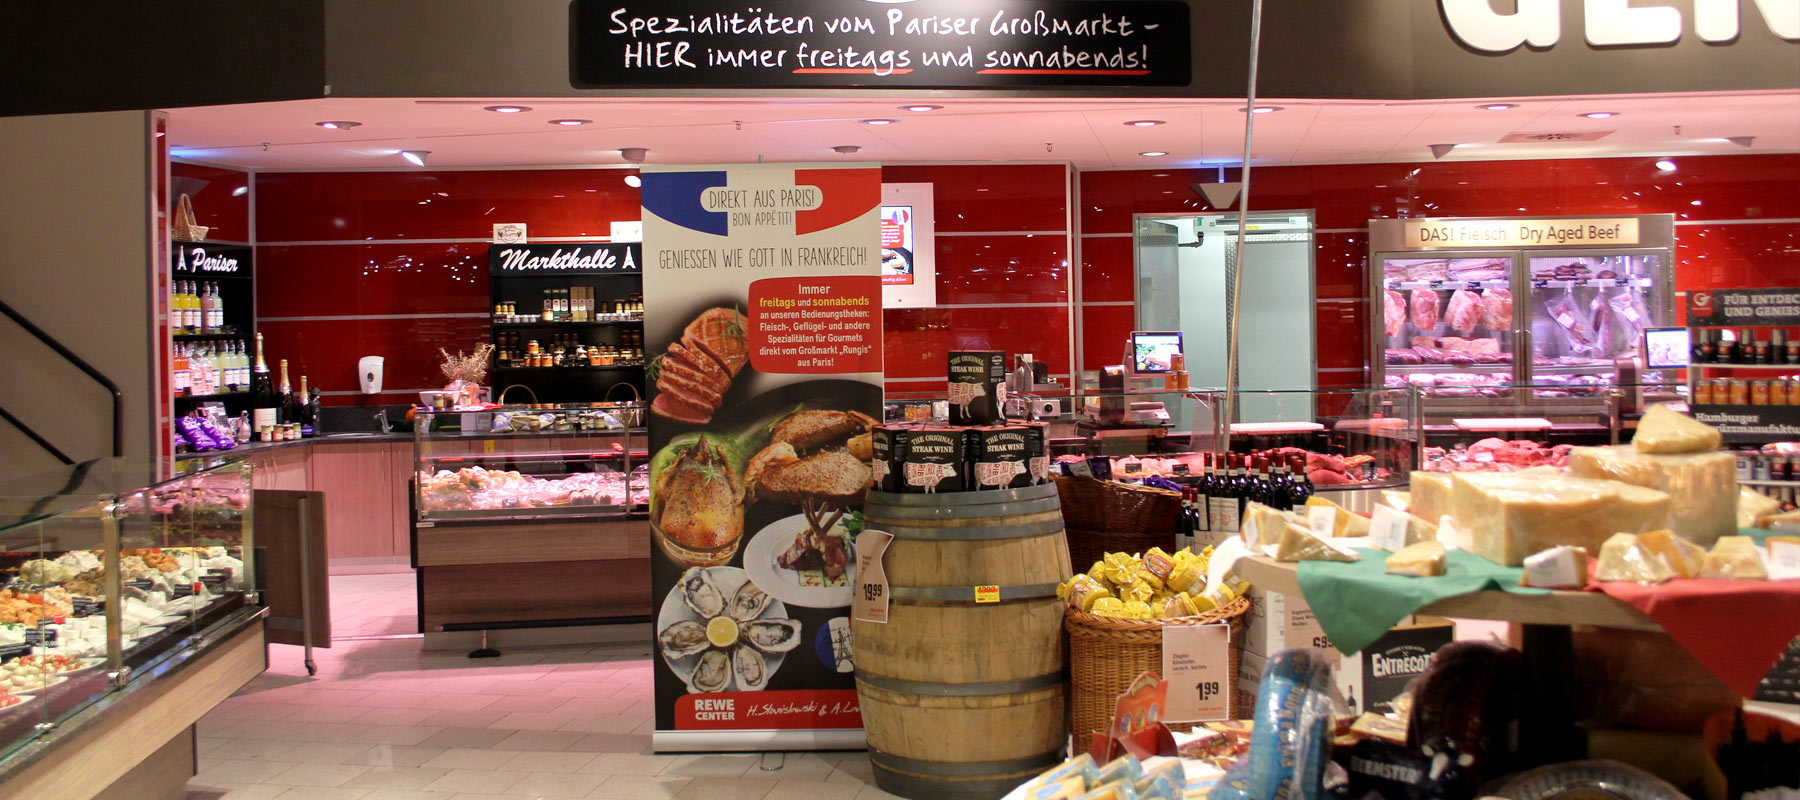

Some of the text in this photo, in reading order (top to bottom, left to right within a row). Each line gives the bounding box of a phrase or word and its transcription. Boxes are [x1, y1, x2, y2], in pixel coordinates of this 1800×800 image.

[610, 8, 814, 37] Spezialitäten
[887, 8, 980, 36] Pariser
[989, 9, 1134, 37] Großmarkt
[624, 41, 1148, 76] HIER immer freitags und sonnabends!
[709, 188, 815, 209] DIREKT AUS PARIS!
[732, 210, 792, 226] BON APPÉTIT!
[1420, 227, 1454, 242] DAS!
[1519, 226, 1544, 244] Dry
[1547, 225, 1584, 244] Aged
[1588, 223, 1620, 240] Beef
[191, 247, 239, 273] Pariser
[500, 247, 617, 271] Markthalle
[659, 246, 867, 269] GENIESSEN WIE GOTT IN FRANKREICH!
[798, 284, 831, 295] Immer
[759, 296, 870, 309] freitags und sonnabends
[1723, 293, 1749, 305] FÜR
[770, 311, 799, 319] unseren
[801, 309, 870, 320] Bedienungstheken:
[1724, 306, 1753, 317] UND
[793, 321, 827, 332] Geflügel-
[828, 321, 842, 330] und
[844, 321, 871, 330] andere
[767, 333, 863, 345] Spezialitäten für Gourmets
[759, 346, 781, 356] direkt
[798, 345, 837, 355] Großmarkt
[812, 358, 834, 367] Paris!
[1695, 412, 1759, 425] Hamburger
[911, 434, 954, 446] THE ORIGINAL
[986, 434, 998, 445] THE
[934, 445, 954, 453] WINE
[987, 443, 1025, 452] STEAK WINE
[1195, 681, 1219, 701] 1.99
[694, 699, 735, 710] REWE
[695, 712, 735, 720] CENTER
